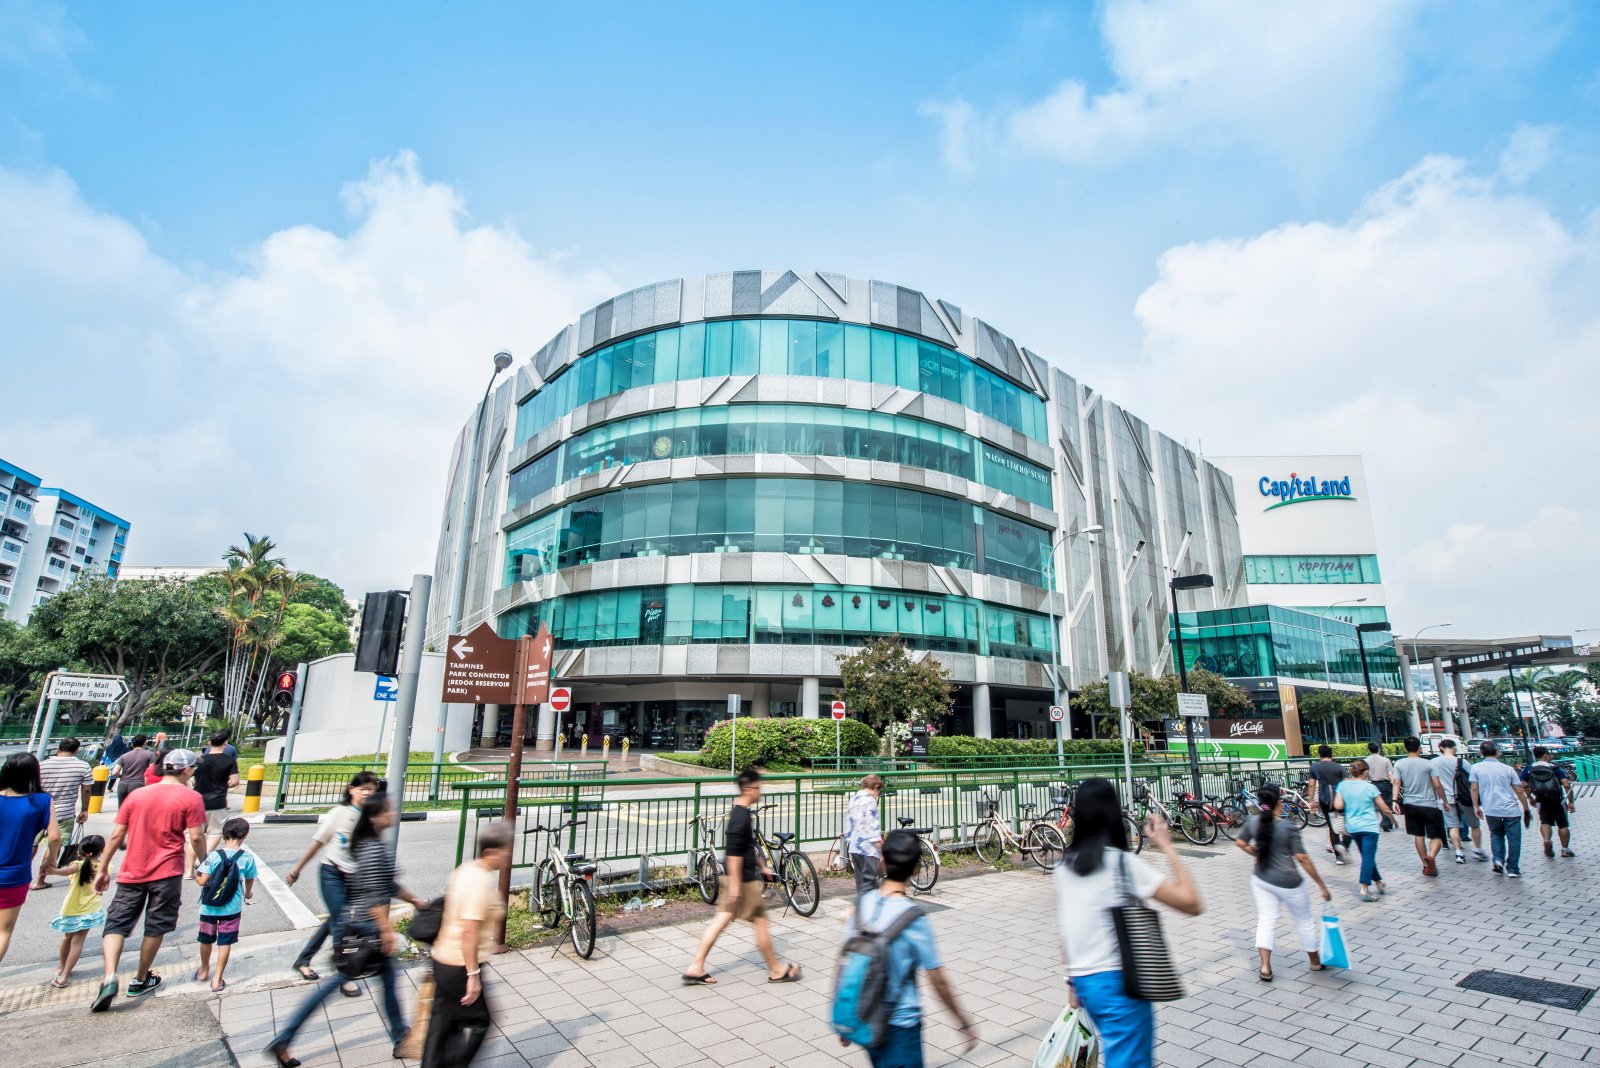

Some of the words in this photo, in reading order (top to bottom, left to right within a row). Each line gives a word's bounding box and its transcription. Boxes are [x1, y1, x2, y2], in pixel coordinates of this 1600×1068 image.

[1030, 470, 1049, 483] SUSHI
[1259, 472, 1351, 501] CapitaLand
[1297, 561, 1354, 572] KOPITIAM
[449, 662, 484, 670] TAMPINES
[468, 671, 510, 679] CONNECTOR
[57, 680, 91, 688] Tampines
[93, 681, 110, 689] Mall
[53, 688, 84, 698] Century
[88, 690, 113, 699] Square
[446, 687, 468, 695] PARK)
